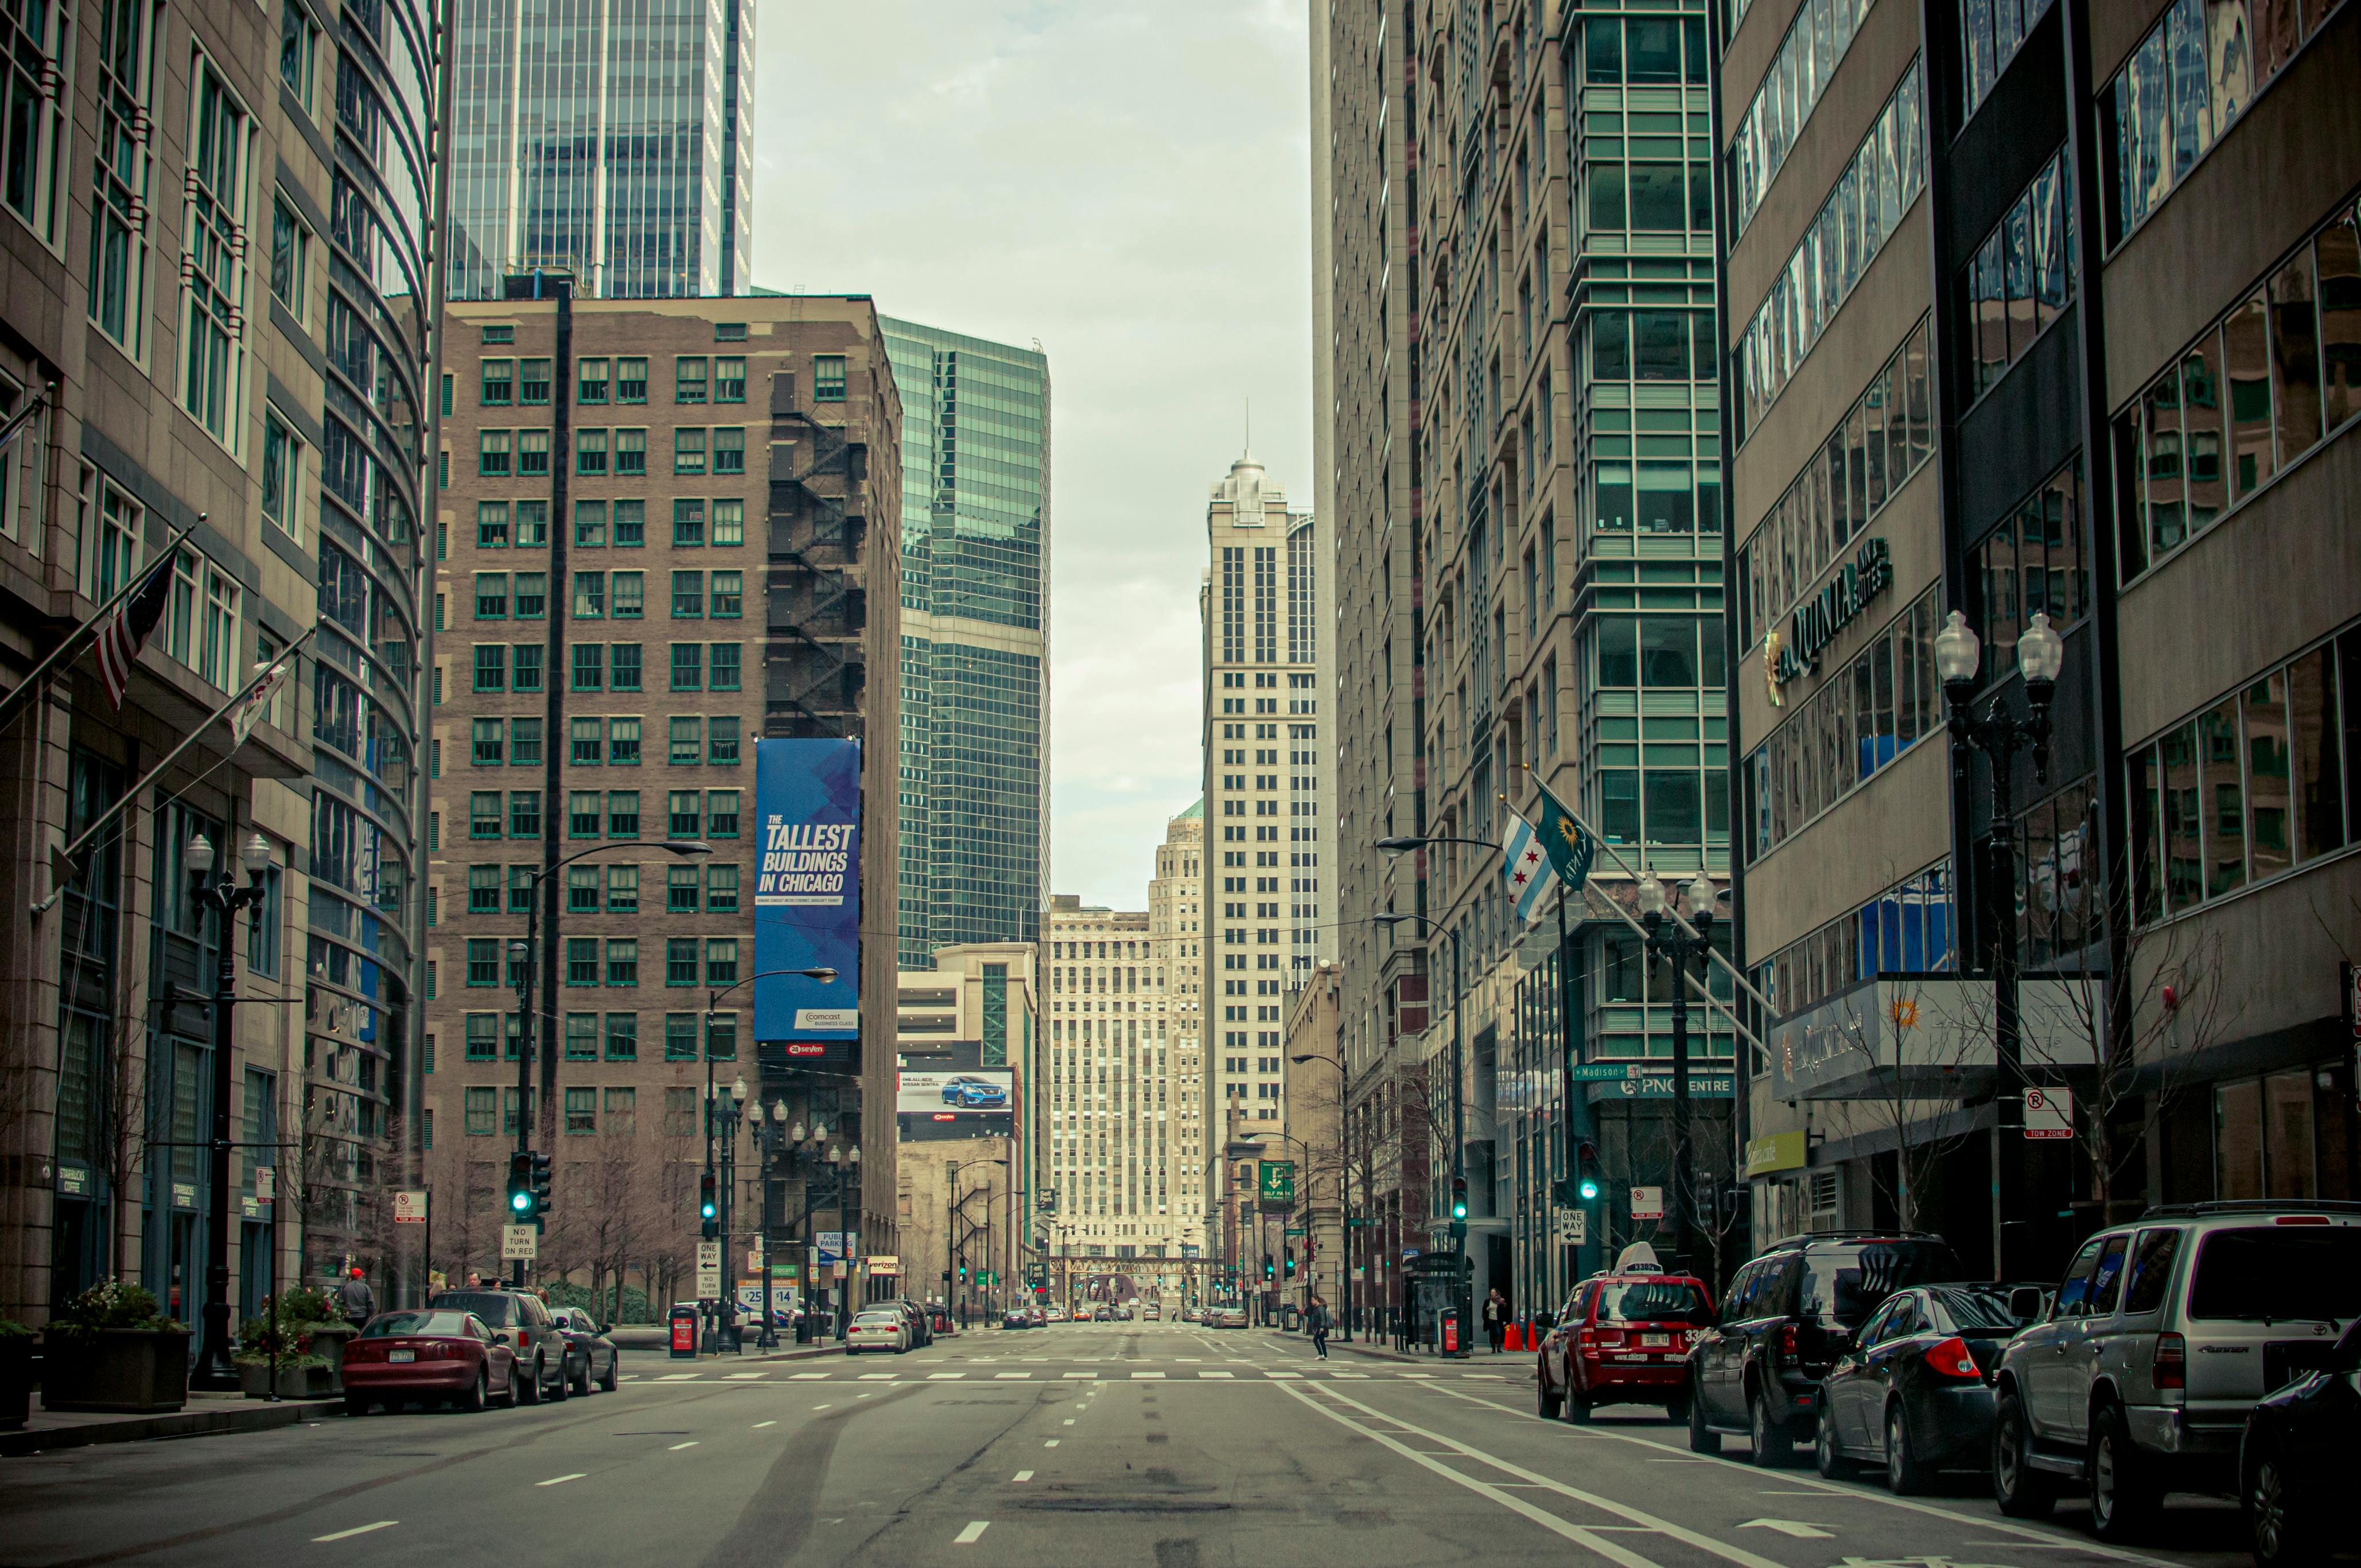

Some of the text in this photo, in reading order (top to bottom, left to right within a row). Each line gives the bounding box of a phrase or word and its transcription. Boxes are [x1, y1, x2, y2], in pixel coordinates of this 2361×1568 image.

[1854, 560, 1882, 610] SUITES
[1790, 563, 1855, 678] QUINTA
[769, 815, 783, 824] THE
[767, 824, 855, 850] TALLEST
[763, 852, 848, 872] BUILDINGS
[759, 874, 844, 892] IN CHICAGO
[1582, 1067, 1618, 1077] Madison
[1689, 1080, 1730, 1091] ENTRE
[60, 1168, 85, 1181] STARBUCKS
[64, 1181, 80, 1193] COFFEE
[174, 1184, 194, 1196] STARBUCKS
[177, 1196, 190, 1206] COFFEE
[245, 1207, 256, 1216] COFFEE
[1563, 1213, 1582, 1221] ONE
[1563, 1222, 1582, 1230] WAY
[745, 1291, 762, 1302] $25
[776, 1291, 791, 1302] $14
[1614, 1352, 1648, 1362] www.chicago
